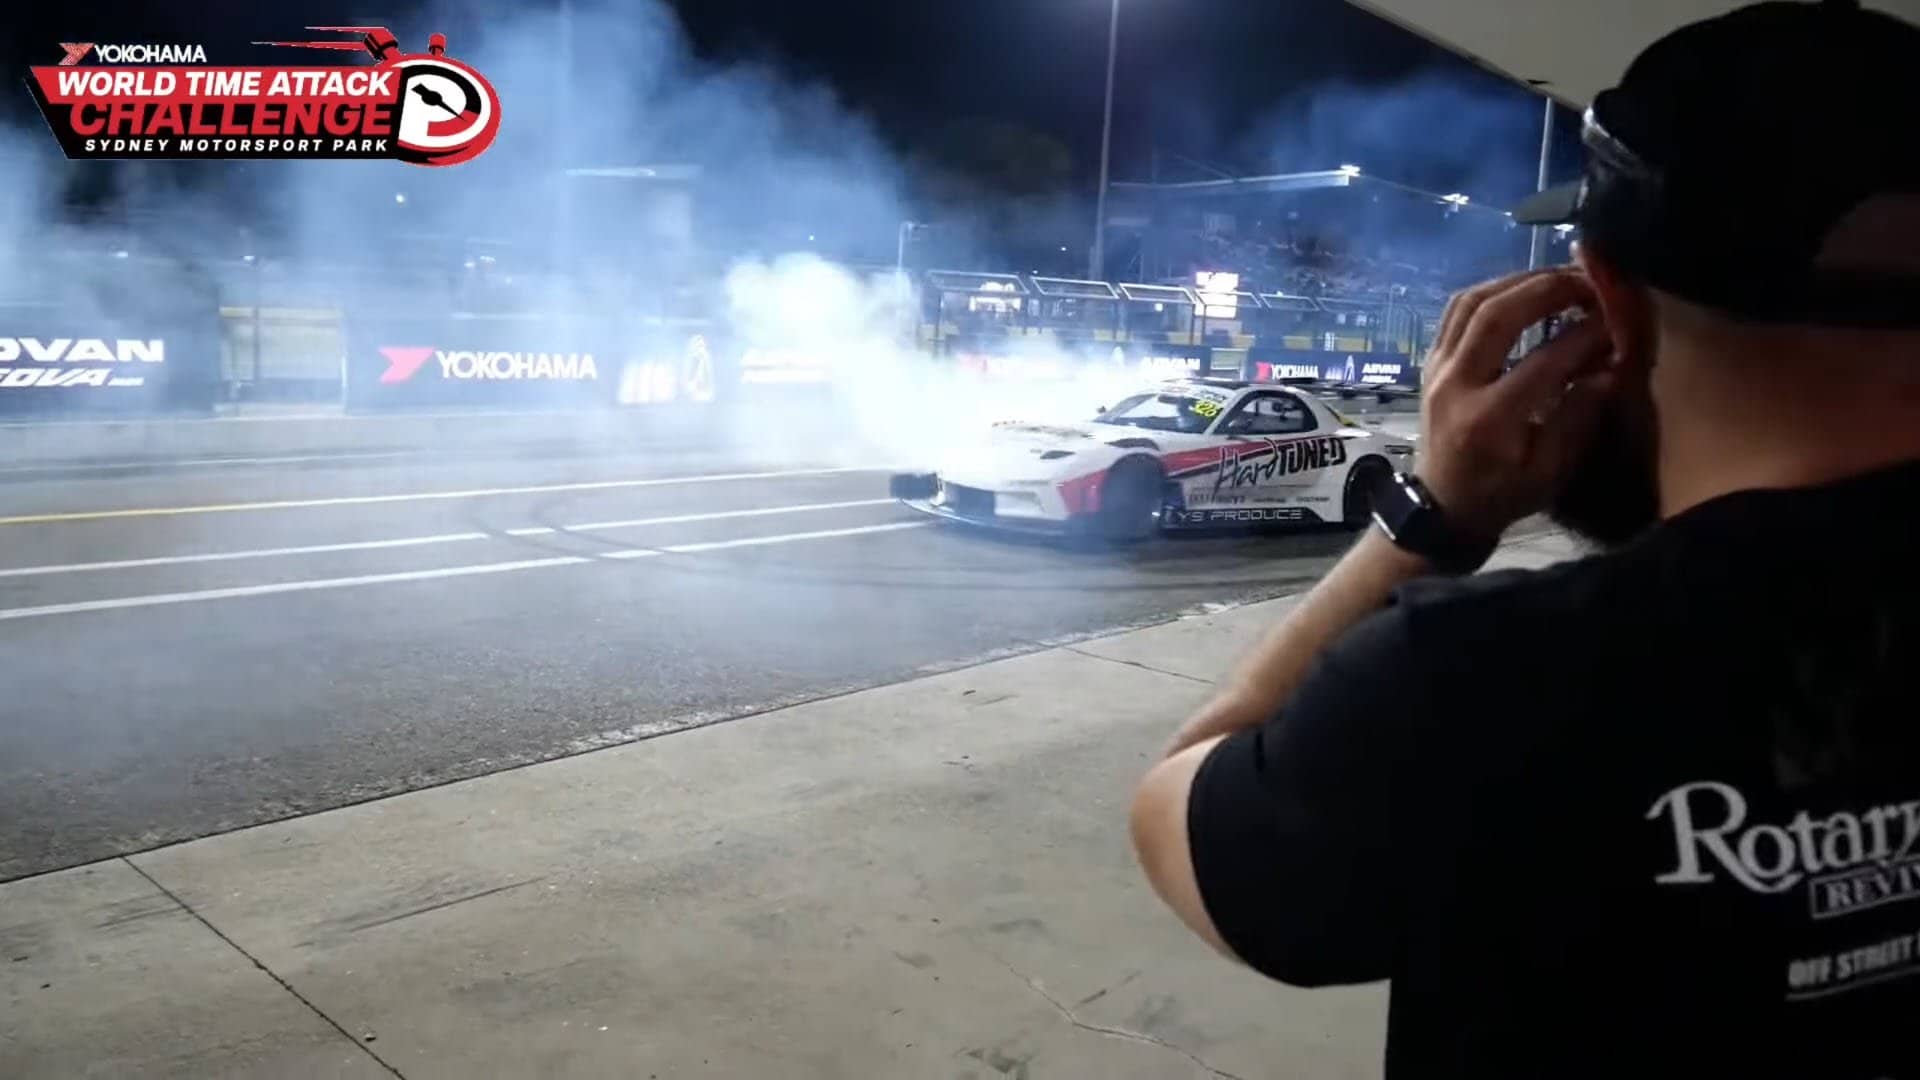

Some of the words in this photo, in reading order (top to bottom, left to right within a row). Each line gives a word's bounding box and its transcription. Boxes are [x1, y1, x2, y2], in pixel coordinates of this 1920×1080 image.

[437, 350, 597, 379] YOKOHAMA
[1271, 364, 1319, 380] YOKOHAMA
[1211, 509, 1303, 520] PRODUCE
